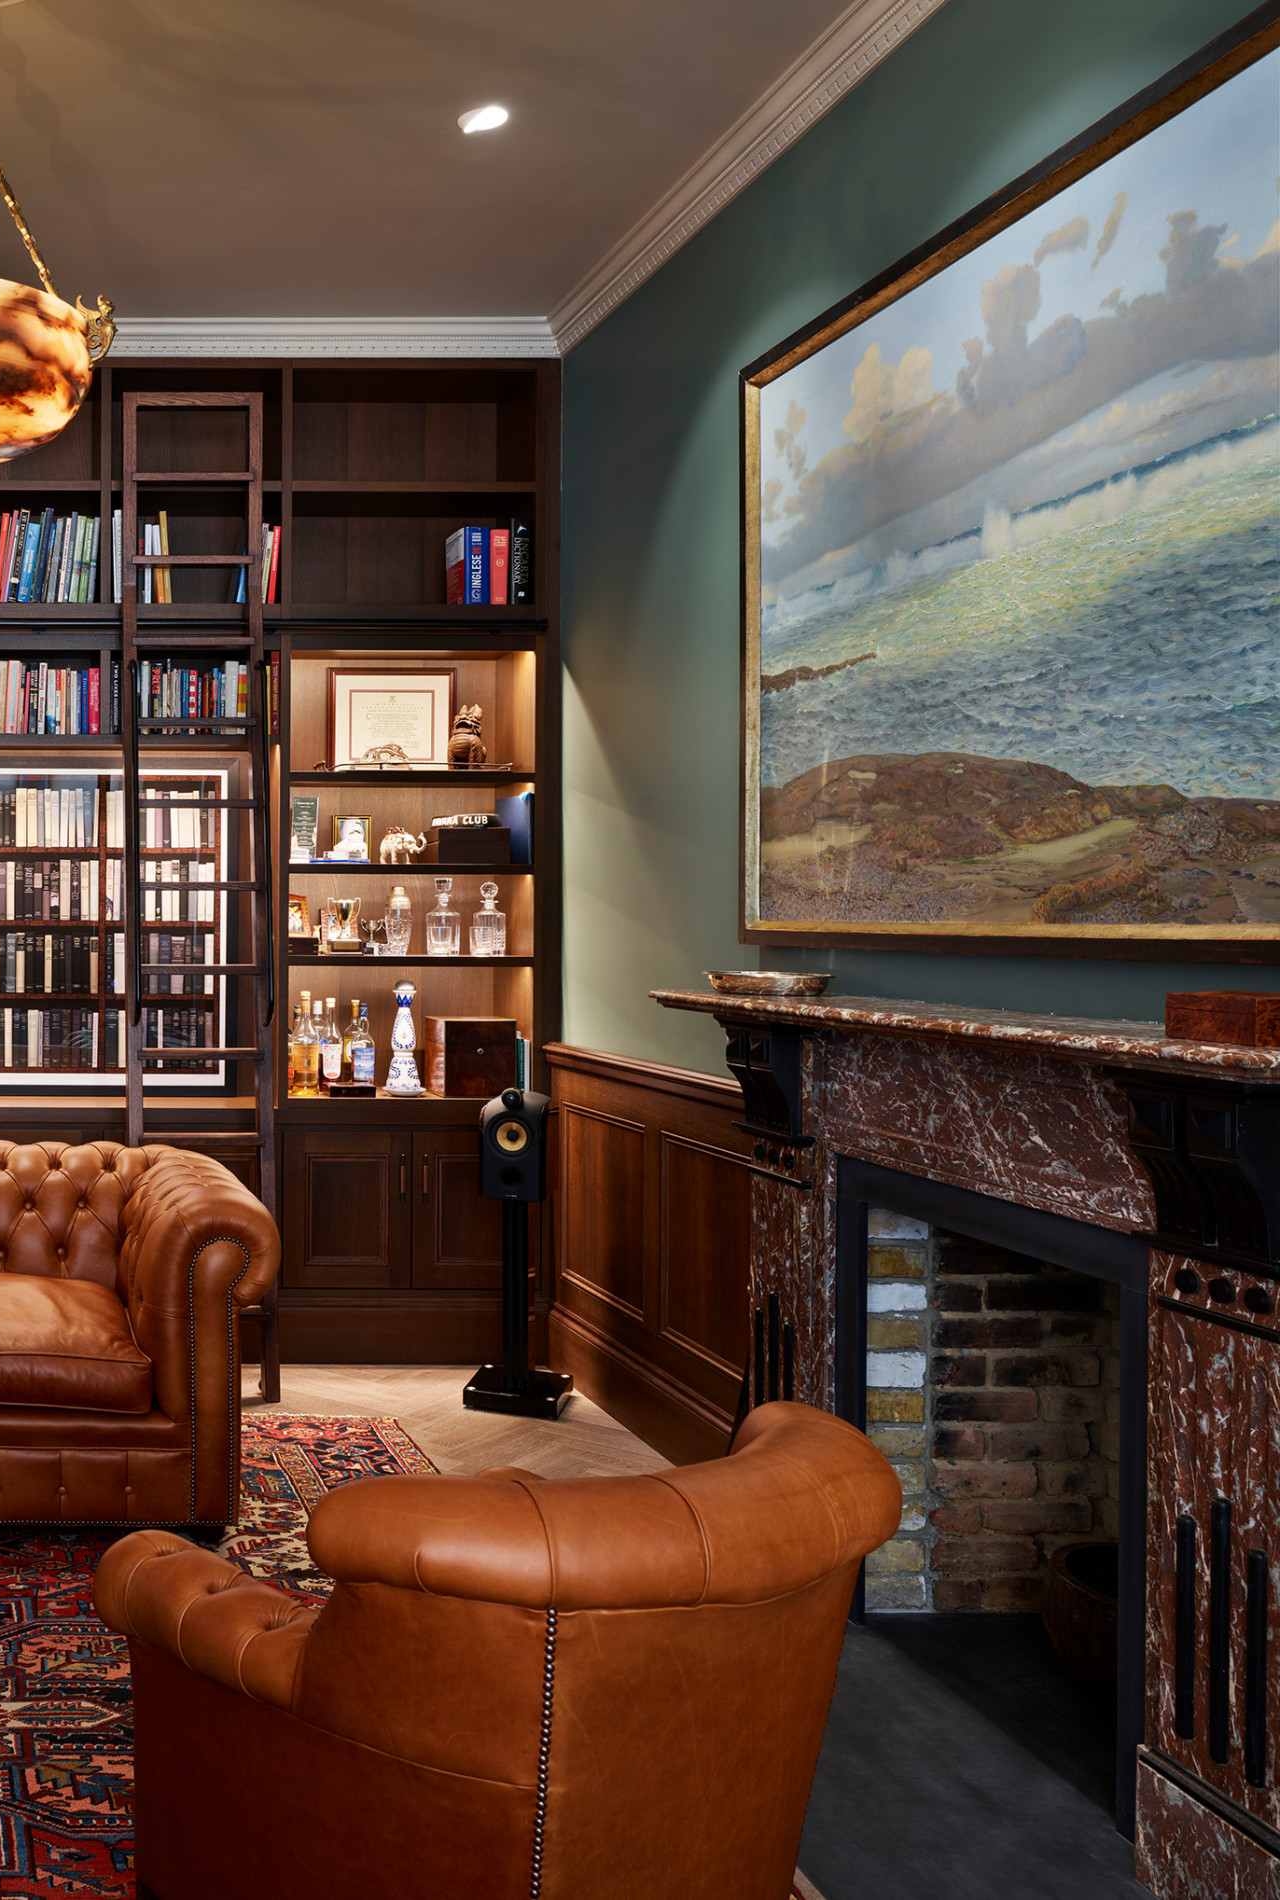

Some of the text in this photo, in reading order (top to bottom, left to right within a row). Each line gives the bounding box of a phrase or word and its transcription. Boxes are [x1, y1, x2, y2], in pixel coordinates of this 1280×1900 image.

[472, 554, 482, 588] INGLESE
[520, 537, 529, 584] ENCARTA
[152, 668, 160, 694] PRIZE
[462, 816, 488, 825] CLUB
